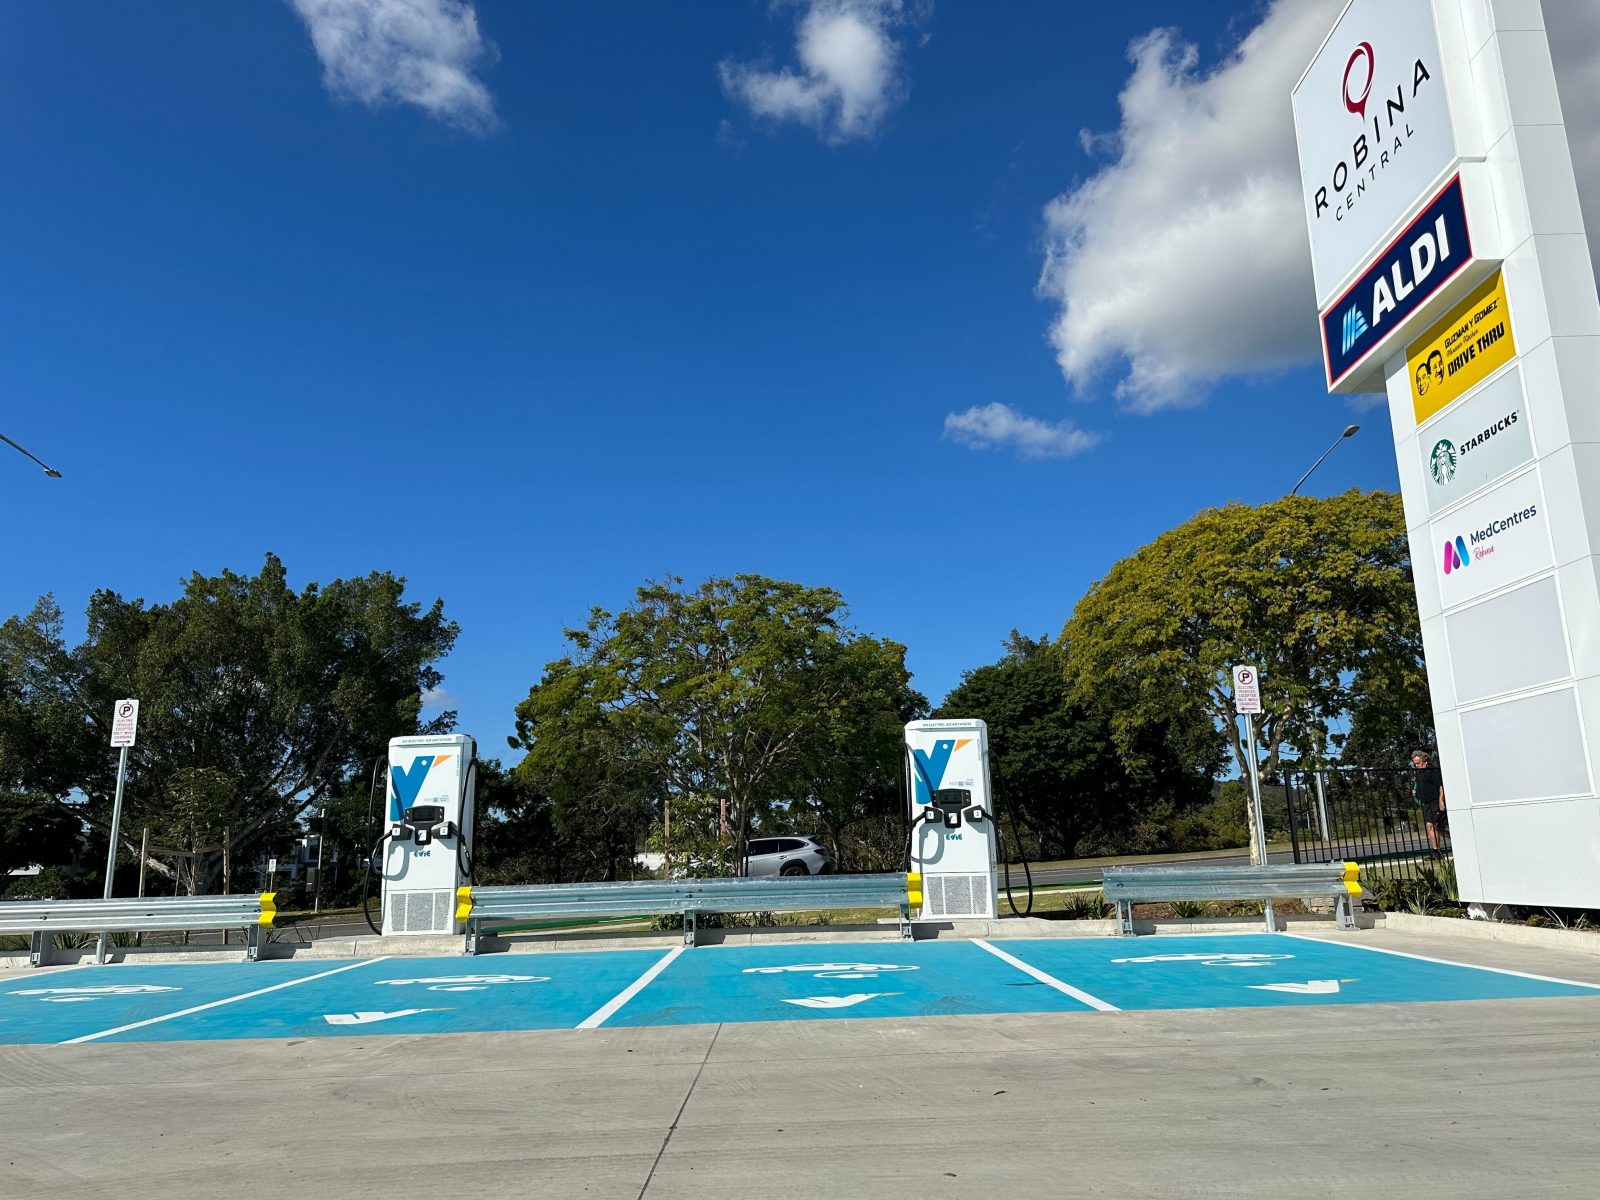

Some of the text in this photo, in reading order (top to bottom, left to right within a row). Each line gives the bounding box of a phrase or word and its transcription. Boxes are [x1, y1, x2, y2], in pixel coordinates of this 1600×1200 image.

[1314, 58, 1431, 219] ROBINA
[1335, 123, 1414, 222] CENTRAL
[1372, 213, 1450, 328] ALDI
[1444, 299, 1498, 349] GUZMAN Y GOMEZ
[1447, 321, 1505, 377] DRIVE THRU
[1460, 411, 1518, 456] STARBUCKS
[1470, 504, 1537, 546] MedCentres
